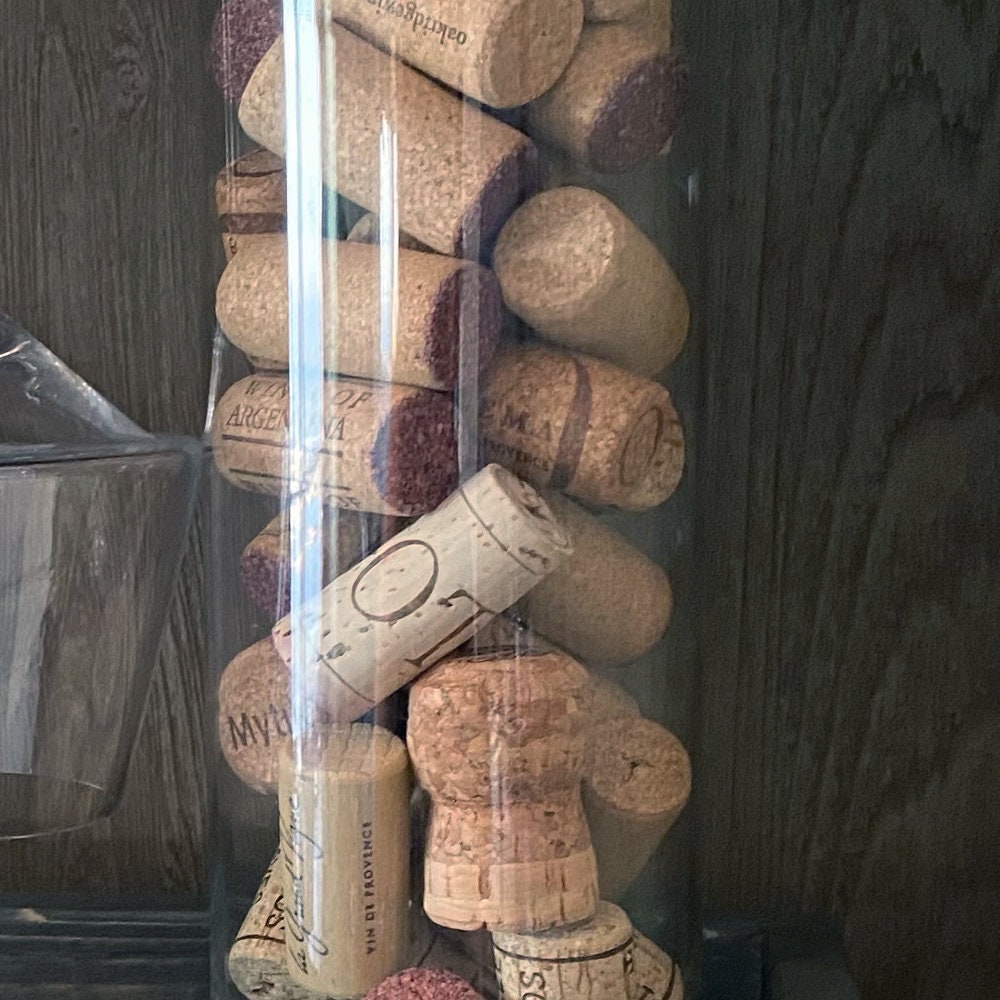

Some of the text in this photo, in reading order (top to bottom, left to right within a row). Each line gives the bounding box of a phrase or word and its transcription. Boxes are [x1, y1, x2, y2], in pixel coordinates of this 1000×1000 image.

[334, 389, 374, 409] OF
[361, 821, 377, 954] VIN DE PROVENCE
